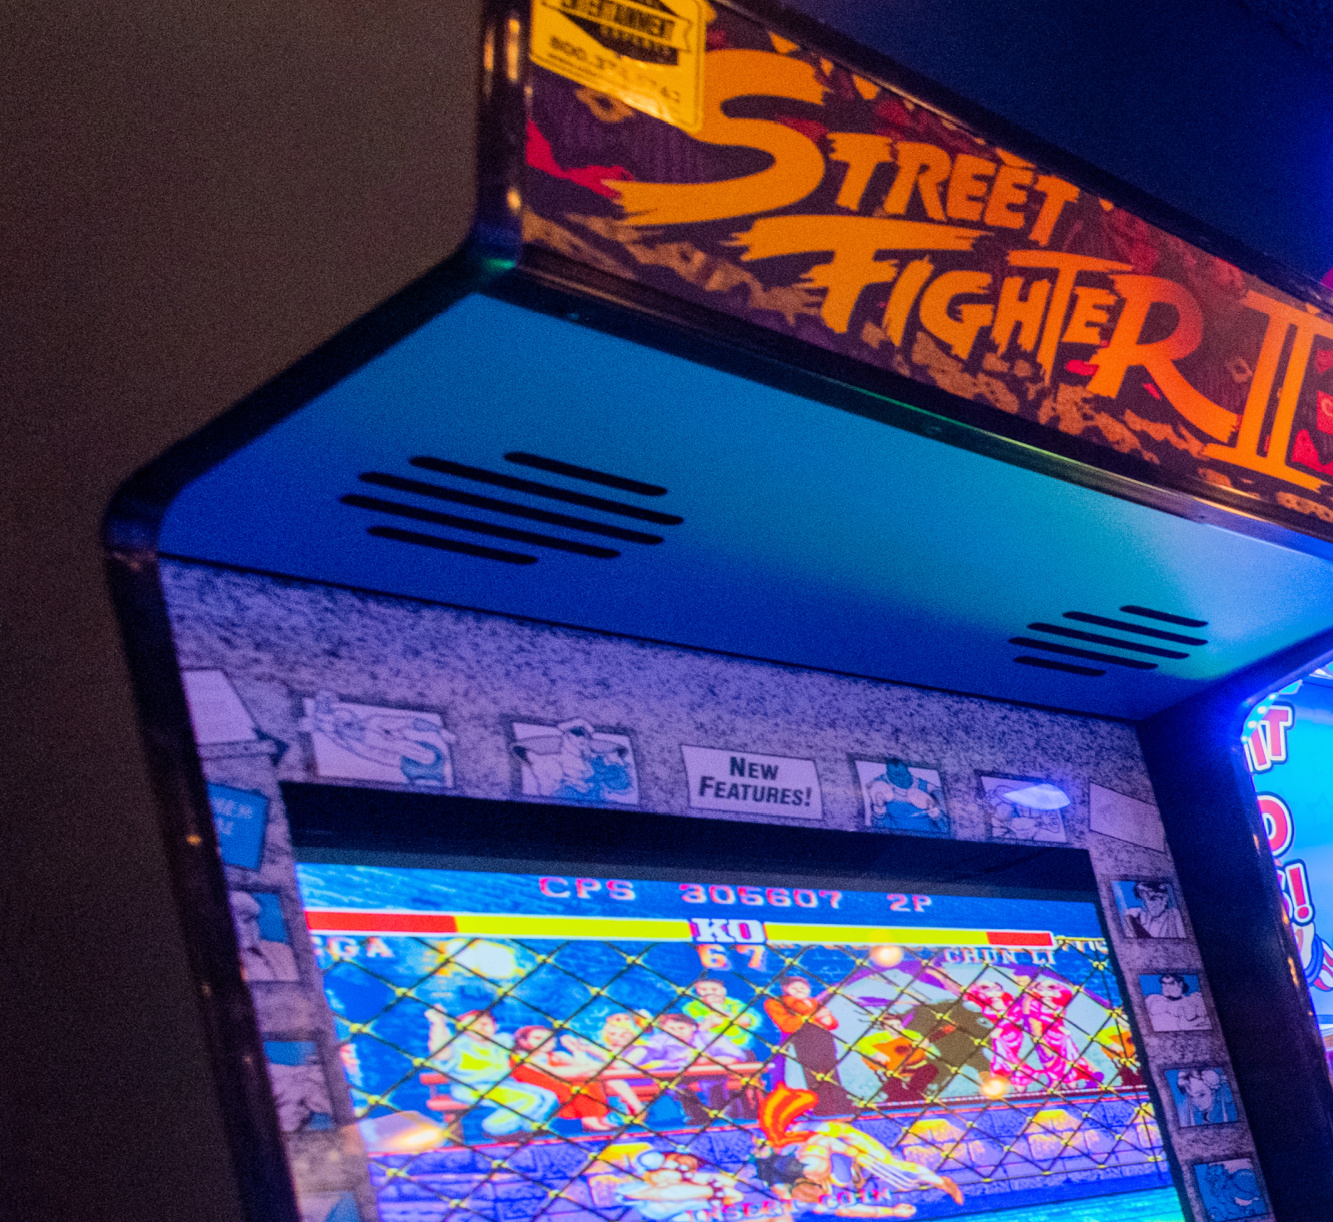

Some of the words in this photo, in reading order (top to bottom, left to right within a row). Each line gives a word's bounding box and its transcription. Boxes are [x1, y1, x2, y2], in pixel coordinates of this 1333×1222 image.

[602, 49, 1078, 249] STREET
[722, 216, 1242, 443] FIGHTER
[1244, 705, 1293, 772] IT
[729, 755, 780, 781] NEW
[698, 775, 813, 807] FEATURES!
[538, 876, 636, 900] CPS
[678, 883, 843, 909] 305607
[886, 893, 932, 912] 2P
[690, 917, 767, 943] KO
[312, 934, 395, 958] GA
[696, 943, 768, 972] 67
[943, 947, 1019, 965] CHUN
[1031, 948, 1057, 965] LI
